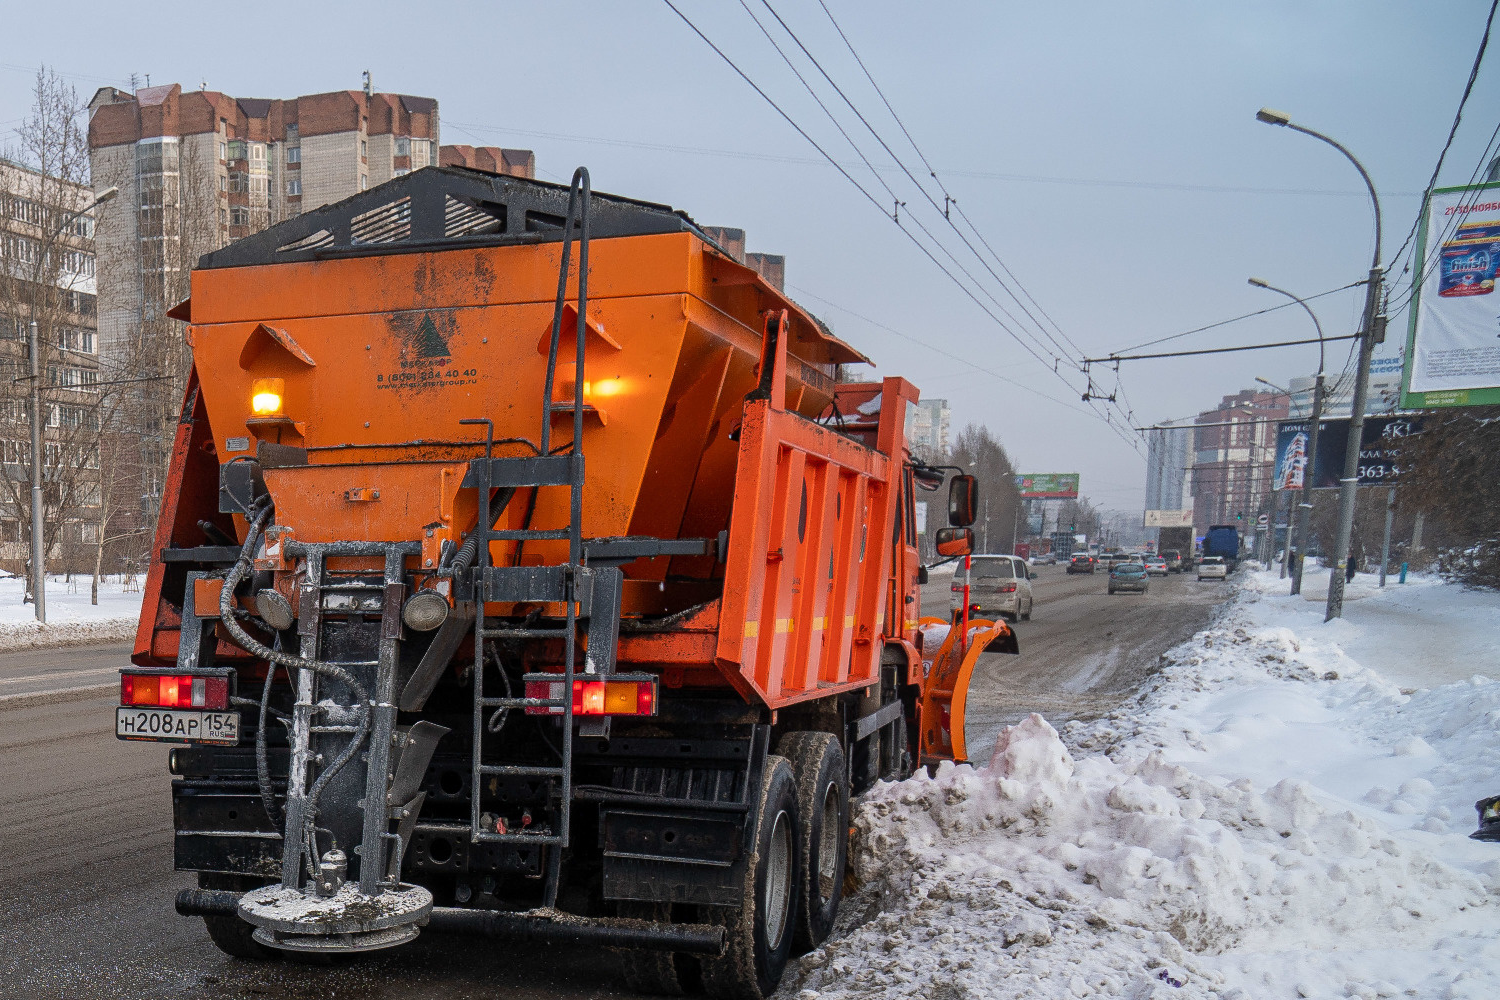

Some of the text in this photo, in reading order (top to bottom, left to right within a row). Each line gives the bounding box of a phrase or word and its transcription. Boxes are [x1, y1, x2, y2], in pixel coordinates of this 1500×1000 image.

[446, 369, 459, 378] 40
[463, 368, 478, 377] 40
[203, 713, 233, 731] 154
[209, 730, 225, 738] RUS
